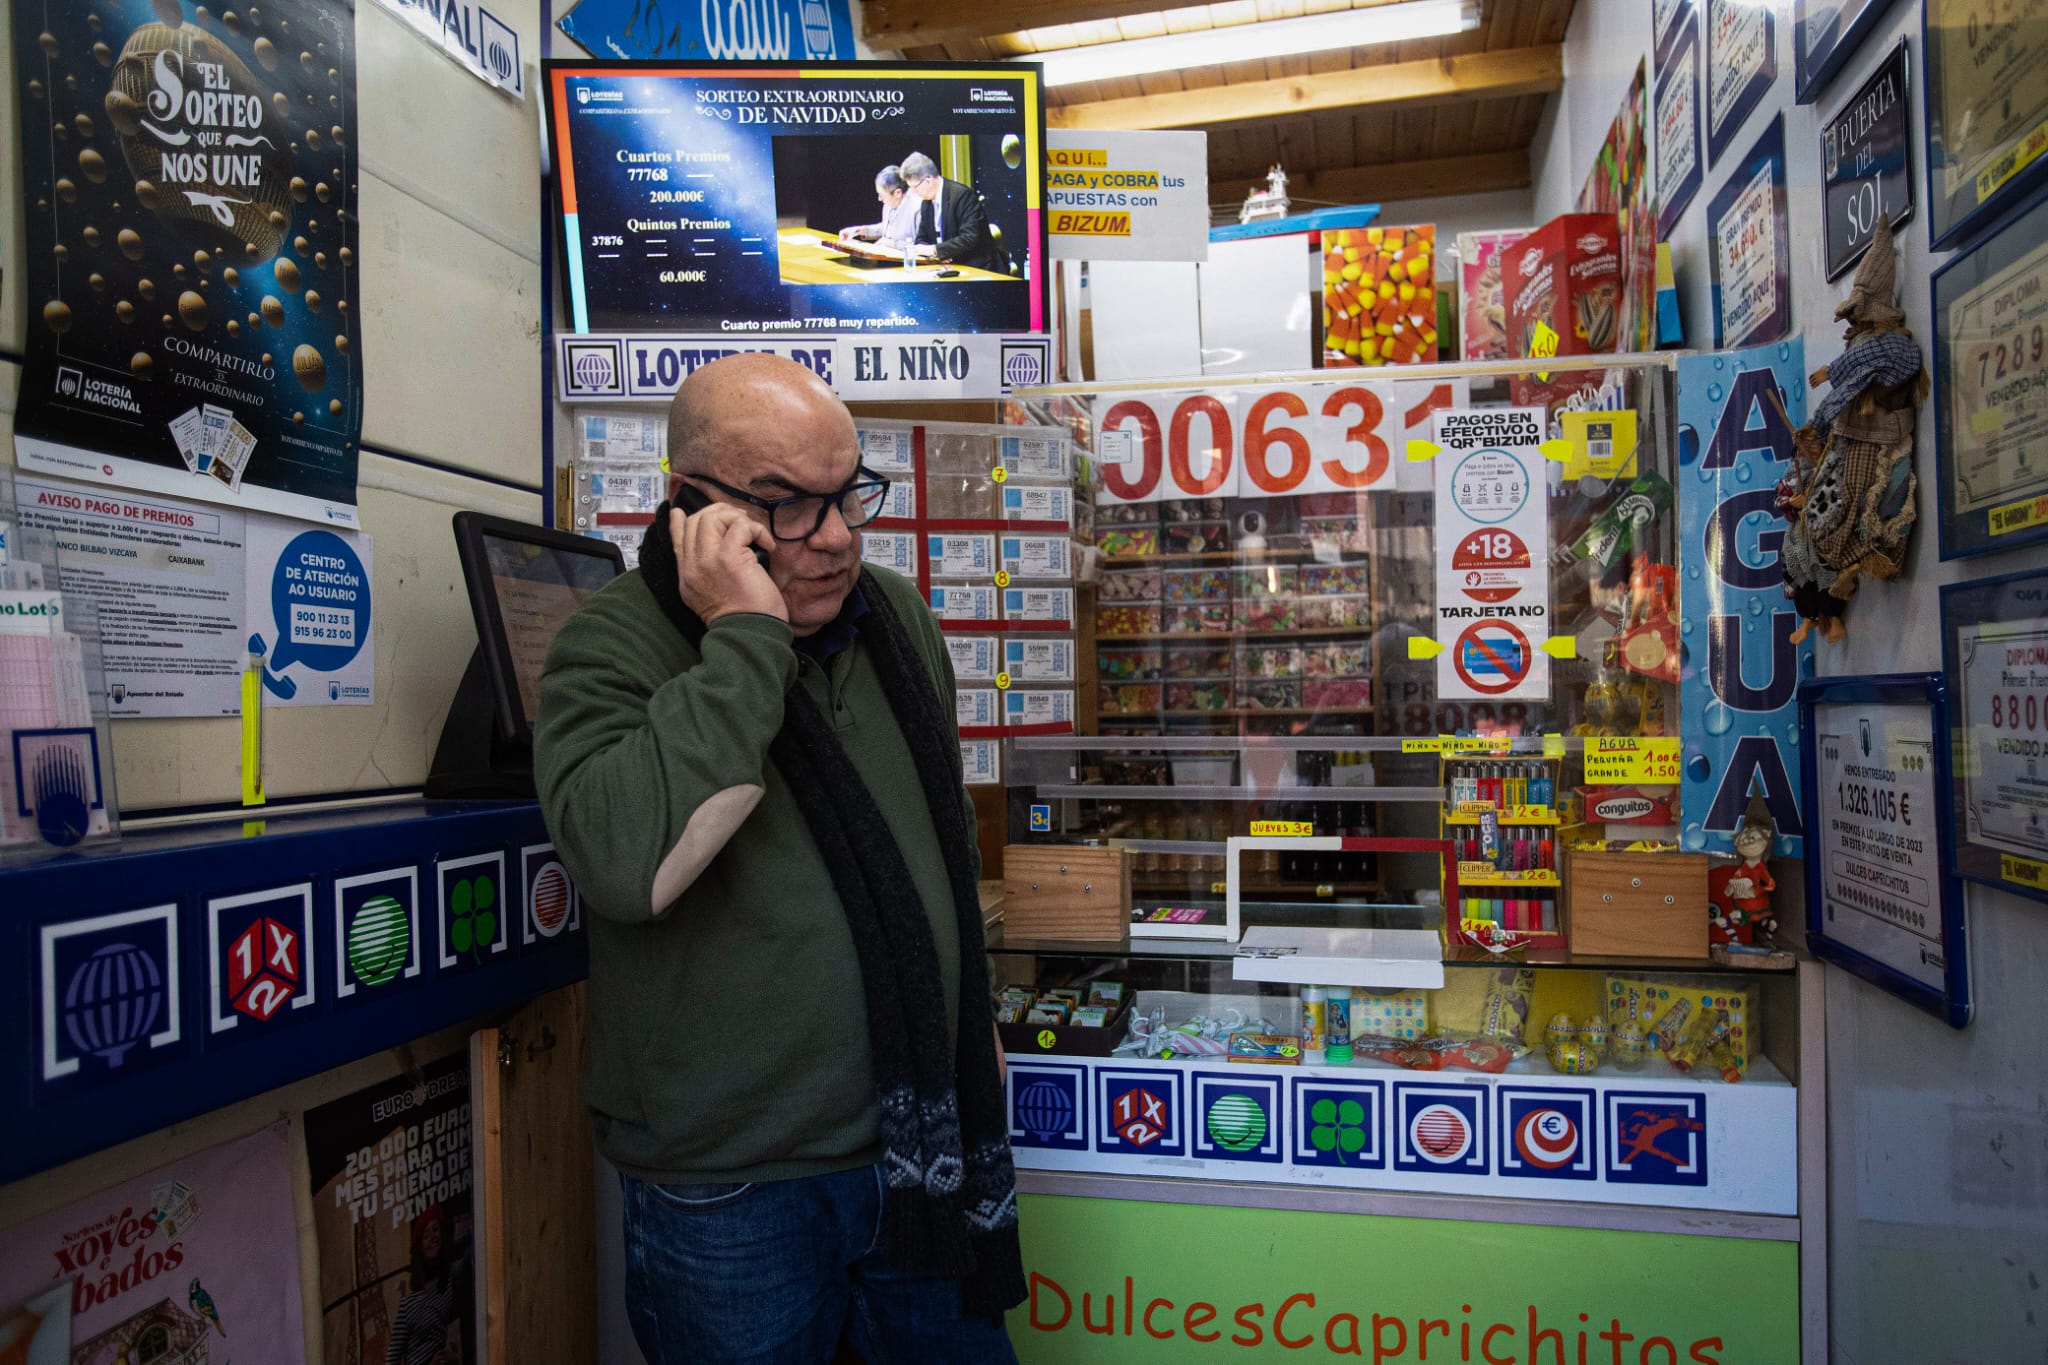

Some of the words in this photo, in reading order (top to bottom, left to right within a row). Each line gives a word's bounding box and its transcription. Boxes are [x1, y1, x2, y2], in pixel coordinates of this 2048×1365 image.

[196, 63, 230, 90] EL
[147, 49, 262, 129] SORTEO
[695, 90, 760, 104] SORTEO
[763, 89, 904, 104] EXTRAORDINARIO
[738, 108, 768, 123] DE
[772, 107, 866, 124] NAVIDAD
[1839, 72, 1897, 158] PUERTA
[197, 131, 222, 148] QUE
[616, 149, 672, 163] Cuartos
[675, 150, 731, 163] Premios
[1855, 140, 1875, 178] DEL
[161, 153, 208, 183] NOS
[213, 155, 261, 186] UNE
[627, 168, 668, 182] 77768
[1047, 173, 1087, 186] PAGA
[1090, 177, 1098, 189] y
[1102, 174, 1159, 187] COBRA
[1162, 175, 1185, 188] tus
[649, 191, 705, 204] 200.000€
[1046, 192, 1127, 206] APUESTAS
[1131, 196, 1158, 207] con
[1847, 169, 1889, 247] SOL
[627, 218, 677, 233] Quintos
[680, 218, 731, 230] Premios
[1057, 215, 1132, 233] BIZUM.
[591, 236, 624, 247] 37876
[659, 271, 707, 283] 60.000€
[1726, 293, 1752, 329] VENDIDO
[1753, 272, 1769, 303] AQUÍ
[1994, 276, 2041, 317] DIPLOMA
[721, 319, 760, 331] Cuarto
[762, 319, 801, 332] premio
[804, 317, 837, 329] 77768
[839, 319, 864, 331] muy
[866, 316, 919, 330] repartido.
[163, 336, 276, 382] COMPARTIRLO
[853, 346, 888, 382] EL
[899, 338, 969, 382] NIÑO
[85, 378, 133, 400] LOTERÍA
[174, 372, 264, 407] EXTRAORDINARIO
[1985, 376, 2030, 409] VENDIDO
[83, 390, 142, 414] NACIONAL
[1447, 413, 1506, 426] PAGOS
[1509, 412, 1532, 424] EN
[1440, 424, 1523, 438] EFECTIVO
[1526, 423, 1539, 434] O
[34, 512, 61, 523] Premios
[38, 491, 81, 510] AVISO
[85, 499, 119, 515] PAGO
[123, 505, 140, 519] DE
[143, 508, 194, 528] PREMIOS
[80, 543, 107, 554] BILBAO
[109, 547, 138, 558] VIZCAYA
[168, 555, 205, 567] CAIXABANK
[1466, 533, 1513, 560] +18
[300, 553, 345, 570] CENTRO
[286, 566, 302, 580] DE
[304, 571, 359, 587] ATENCIÓN
[998, 572, 1007, 586] 8
[288, 583, 306, 596] AO
[308, 586, 357, 602] USUARIO
[296, 611, 316, 622] 900
[318, 613, 326, 623] 11
[328, 614, 339, 624] 23
[341, 615, 350, 625] 13
[1440, 607, 1517, 618] TARJETA
[1520, 606, 1545, 617] NO
[294, 626, 310, 637] 915
[312, 627, 324, 638] 96
[326, 628, 337, 639] 23
[339, 629, 351, 640] 00
[999, 675, 1009, 687] 9
[2002, 671, 2028, 688] Primer
[1599, 738, 1637, 749] AGUA
[1996, 737, 2040, 759] VENDIDO
[1587, 769, 1628, 778] GRANDE
[1862, 765, 1896, 783] ENTREGADO
[1462, 802, 1491, 811] CLIPPER
[1518, 805, 1527, 818] 2
[1597, 801, 1651, 816] conguitos
[1838, 781, 1896, 823] 1.326.105
[1900, 792, 1911, 826] €
[1481, 814, 1493, 844] OCB
[1832, 818, 1839, 830] EN
[1840, 820, 1861, 837] PREMIOS
[1867, 828, 1874, 841] LO
[1874, 831, 1895, 847] LARGO
[1896, 834, 1905, 849] DE
[1906, 839, 1923, 853] 2023
[1841, 835, 1849, 847] EN
[1849, 838, 1861, 852] ESTE
[1862, 841, 1880, 857] PUNTO
[1881, 846, 1890, 860] DE
[1890, 848, 1912, 867] VENTA
[1462, 864, 1491, 873] CLIPPER
[1845, 860, 1867, 880] DULCES
[1868, 865, 1910, 895] CAPRICHITOS
[345, 1125, 420, 1178] 20.000
[423, 1103, 471, 1140] EURO
[335, 1168, 379, 1209] MES
[383, 1142, 433, 1186] PARA
[349, 1191, 378, 1226] TU
[382, 1159, 444, 1211] SUEÑO
[447, 1147, 470, 1177] DE
[63, 1220, 104, 1245] Sorteos
[106, 1213, 118, 1227] de
[53, 1206, 158, 1280] xoves
[100, 1255, 111, 1271] e
[72, 1242, 184, 1316] bados
